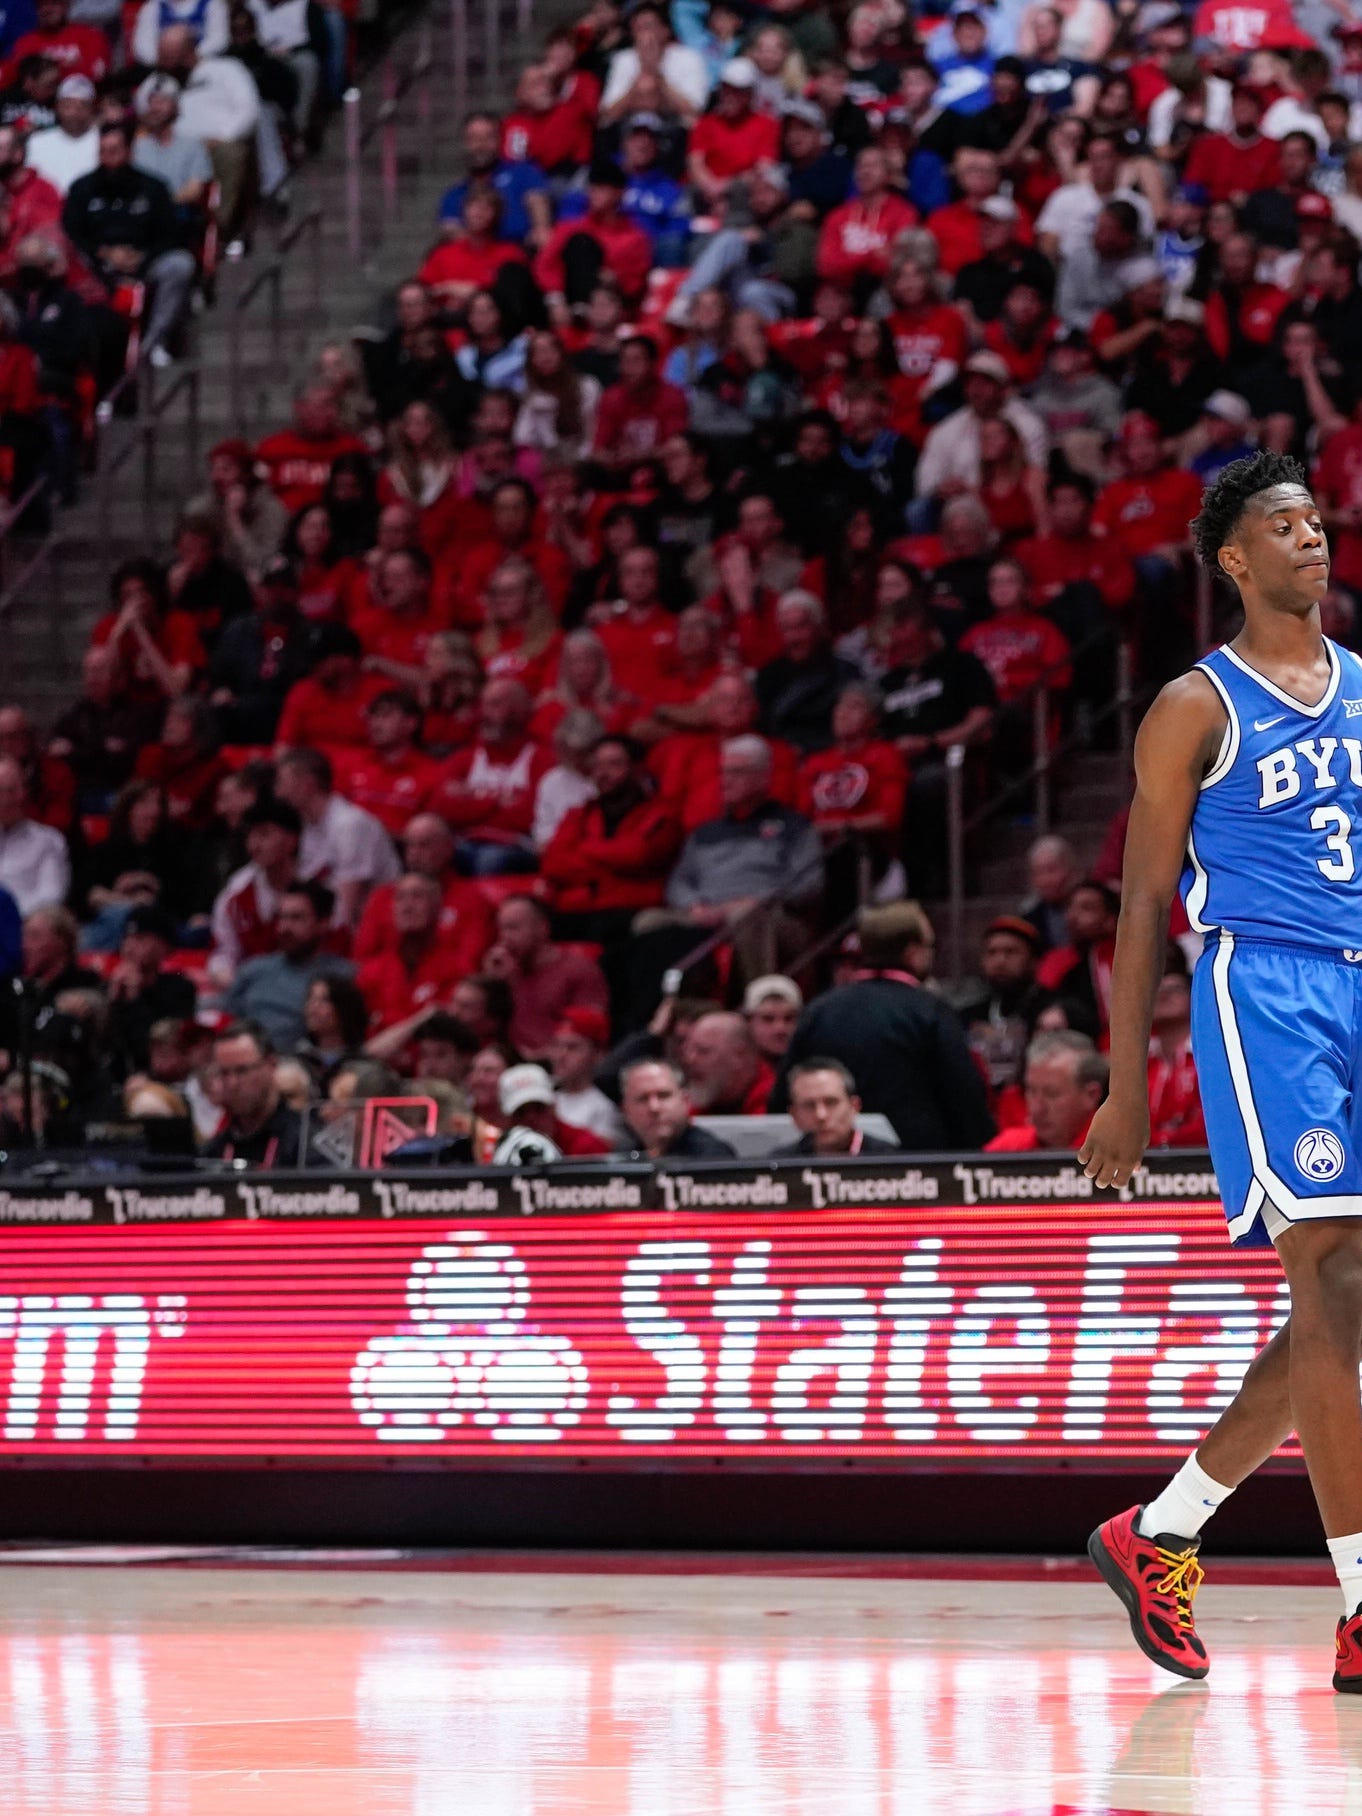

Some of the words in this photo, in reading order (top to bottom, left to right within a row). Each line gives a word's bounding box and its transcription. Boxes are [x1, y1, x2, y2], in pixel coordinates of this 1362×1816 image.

[1310, 805, 1355, 881] 3
[391, 1181, 498, 1211] Trucordia
[532, 1177, 641, 1208] Trucordia
[675, 1174, 787, 1206] Trucordia
[824, 1169, 938, 1201] Trucordia
[974, 1167, 1093, 1198] Trucordia
[256, 1184, 359, 1215] Trucordia
